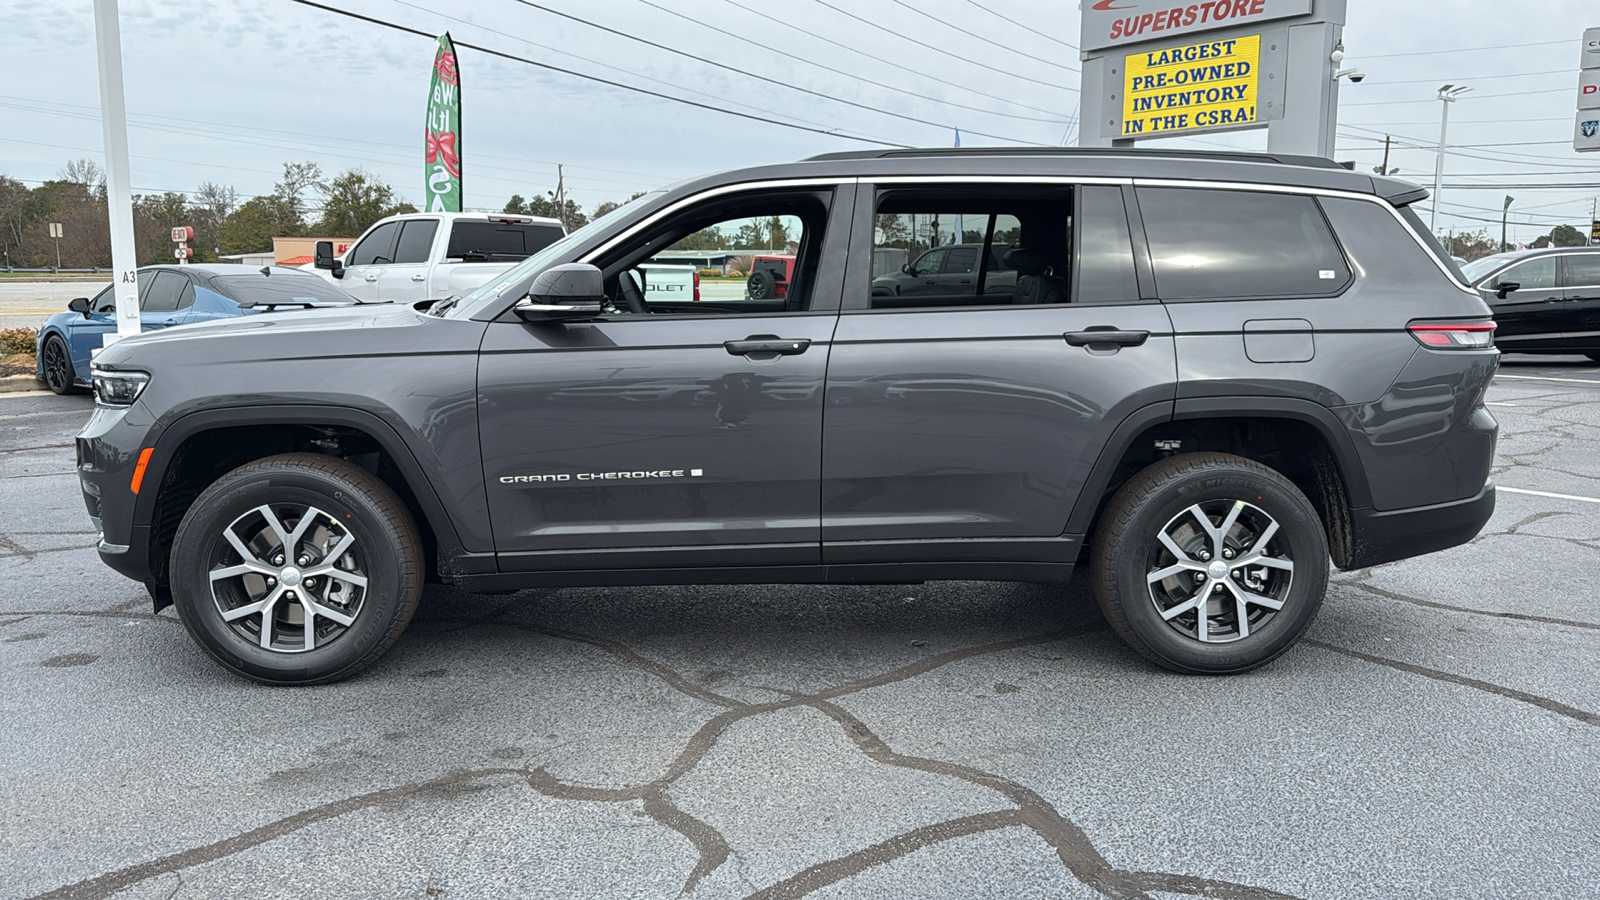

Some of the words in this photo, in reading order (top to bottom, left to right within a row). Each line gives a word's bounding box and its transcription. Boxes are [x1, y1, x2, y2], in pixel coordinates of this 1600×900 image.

[1109, 0, 1266, 40] SUPERSTORE
[1147, 40, 1236, 67] LARGEST
[1132, 61, 1251, 91] PRE-OWNED
[1132, 84, 1249, 111] INVENTORY
[1124, 119, 1144, 133] IN
[1150, 114, 1188, 130] THE
[1195, 106, 1255, 126] CSRA!
[122, 270, 135, 283] A3
[499, 474, 570, 484] GRAND
[576, 469, 684, 481] CHEROKEE
